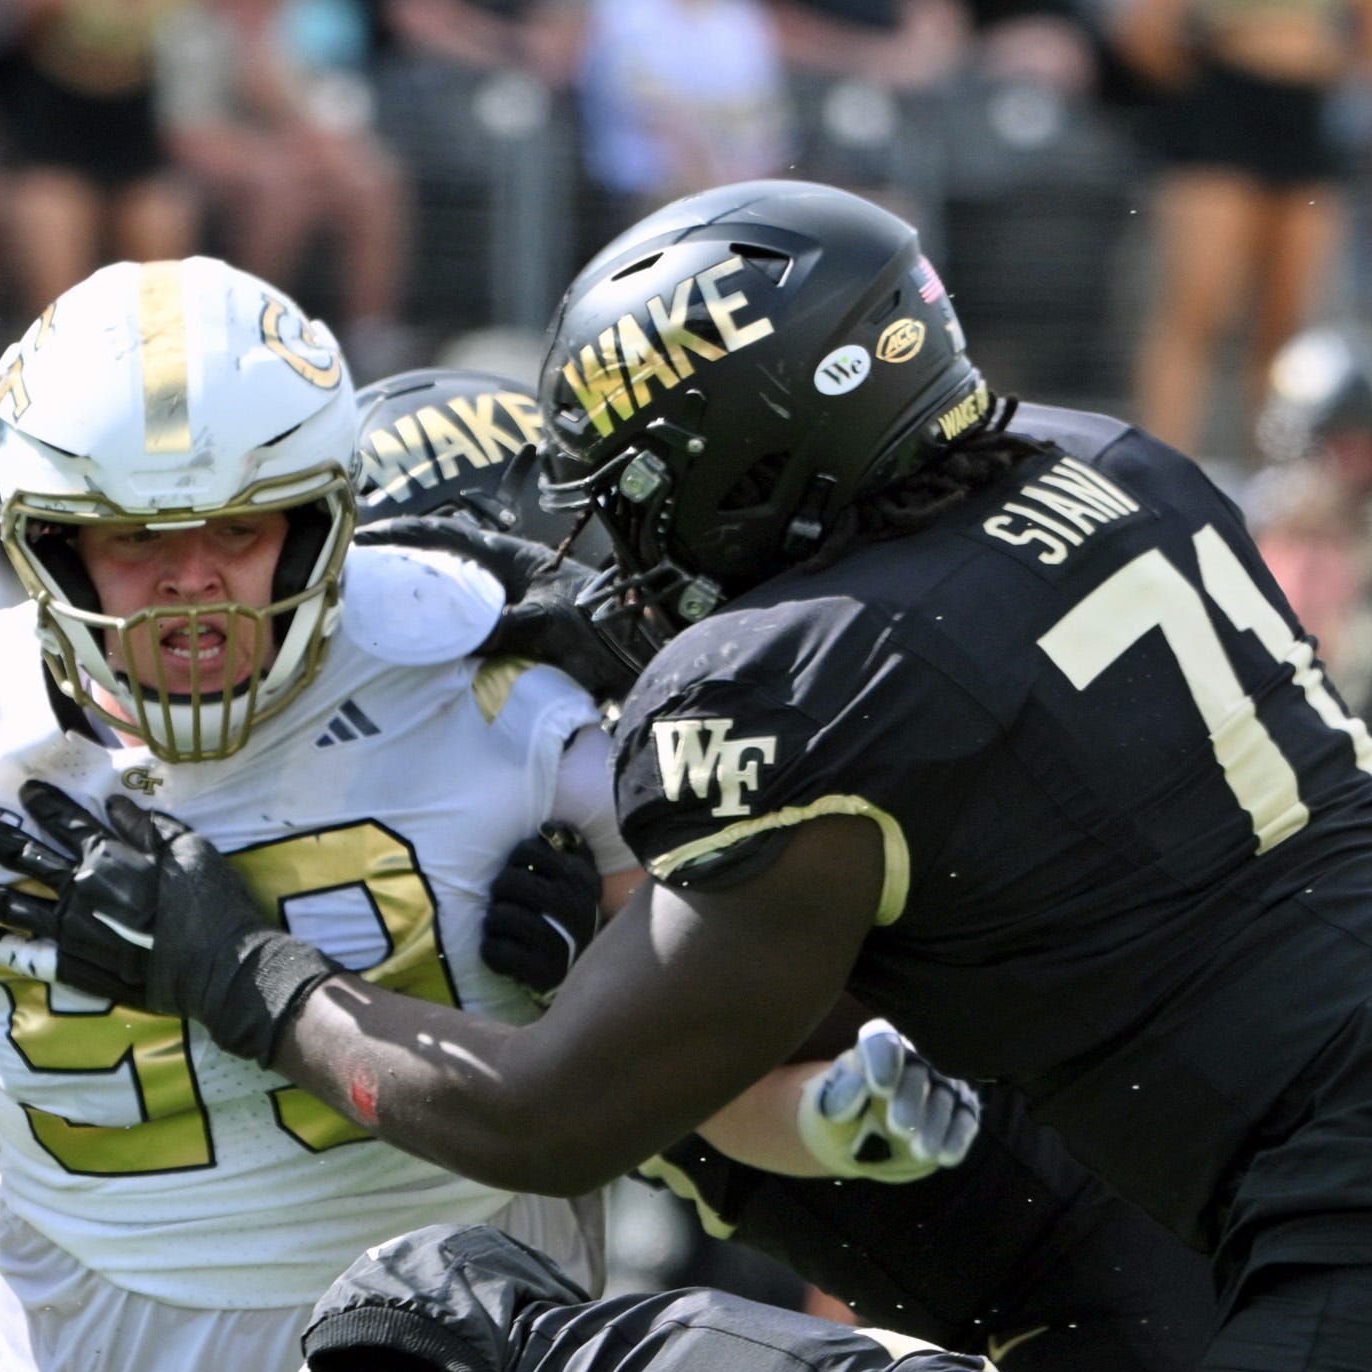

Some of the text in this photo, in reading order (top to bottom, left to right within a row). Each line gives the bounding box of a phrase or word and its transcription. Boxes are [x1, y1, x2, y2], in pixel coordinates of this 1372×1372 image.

[563, 256, 775, 438] WAKE
[982, 456, 1140, 566] SIANI
[121, 767, 164, 796] GT
[652, 718, 777, 818] WF
